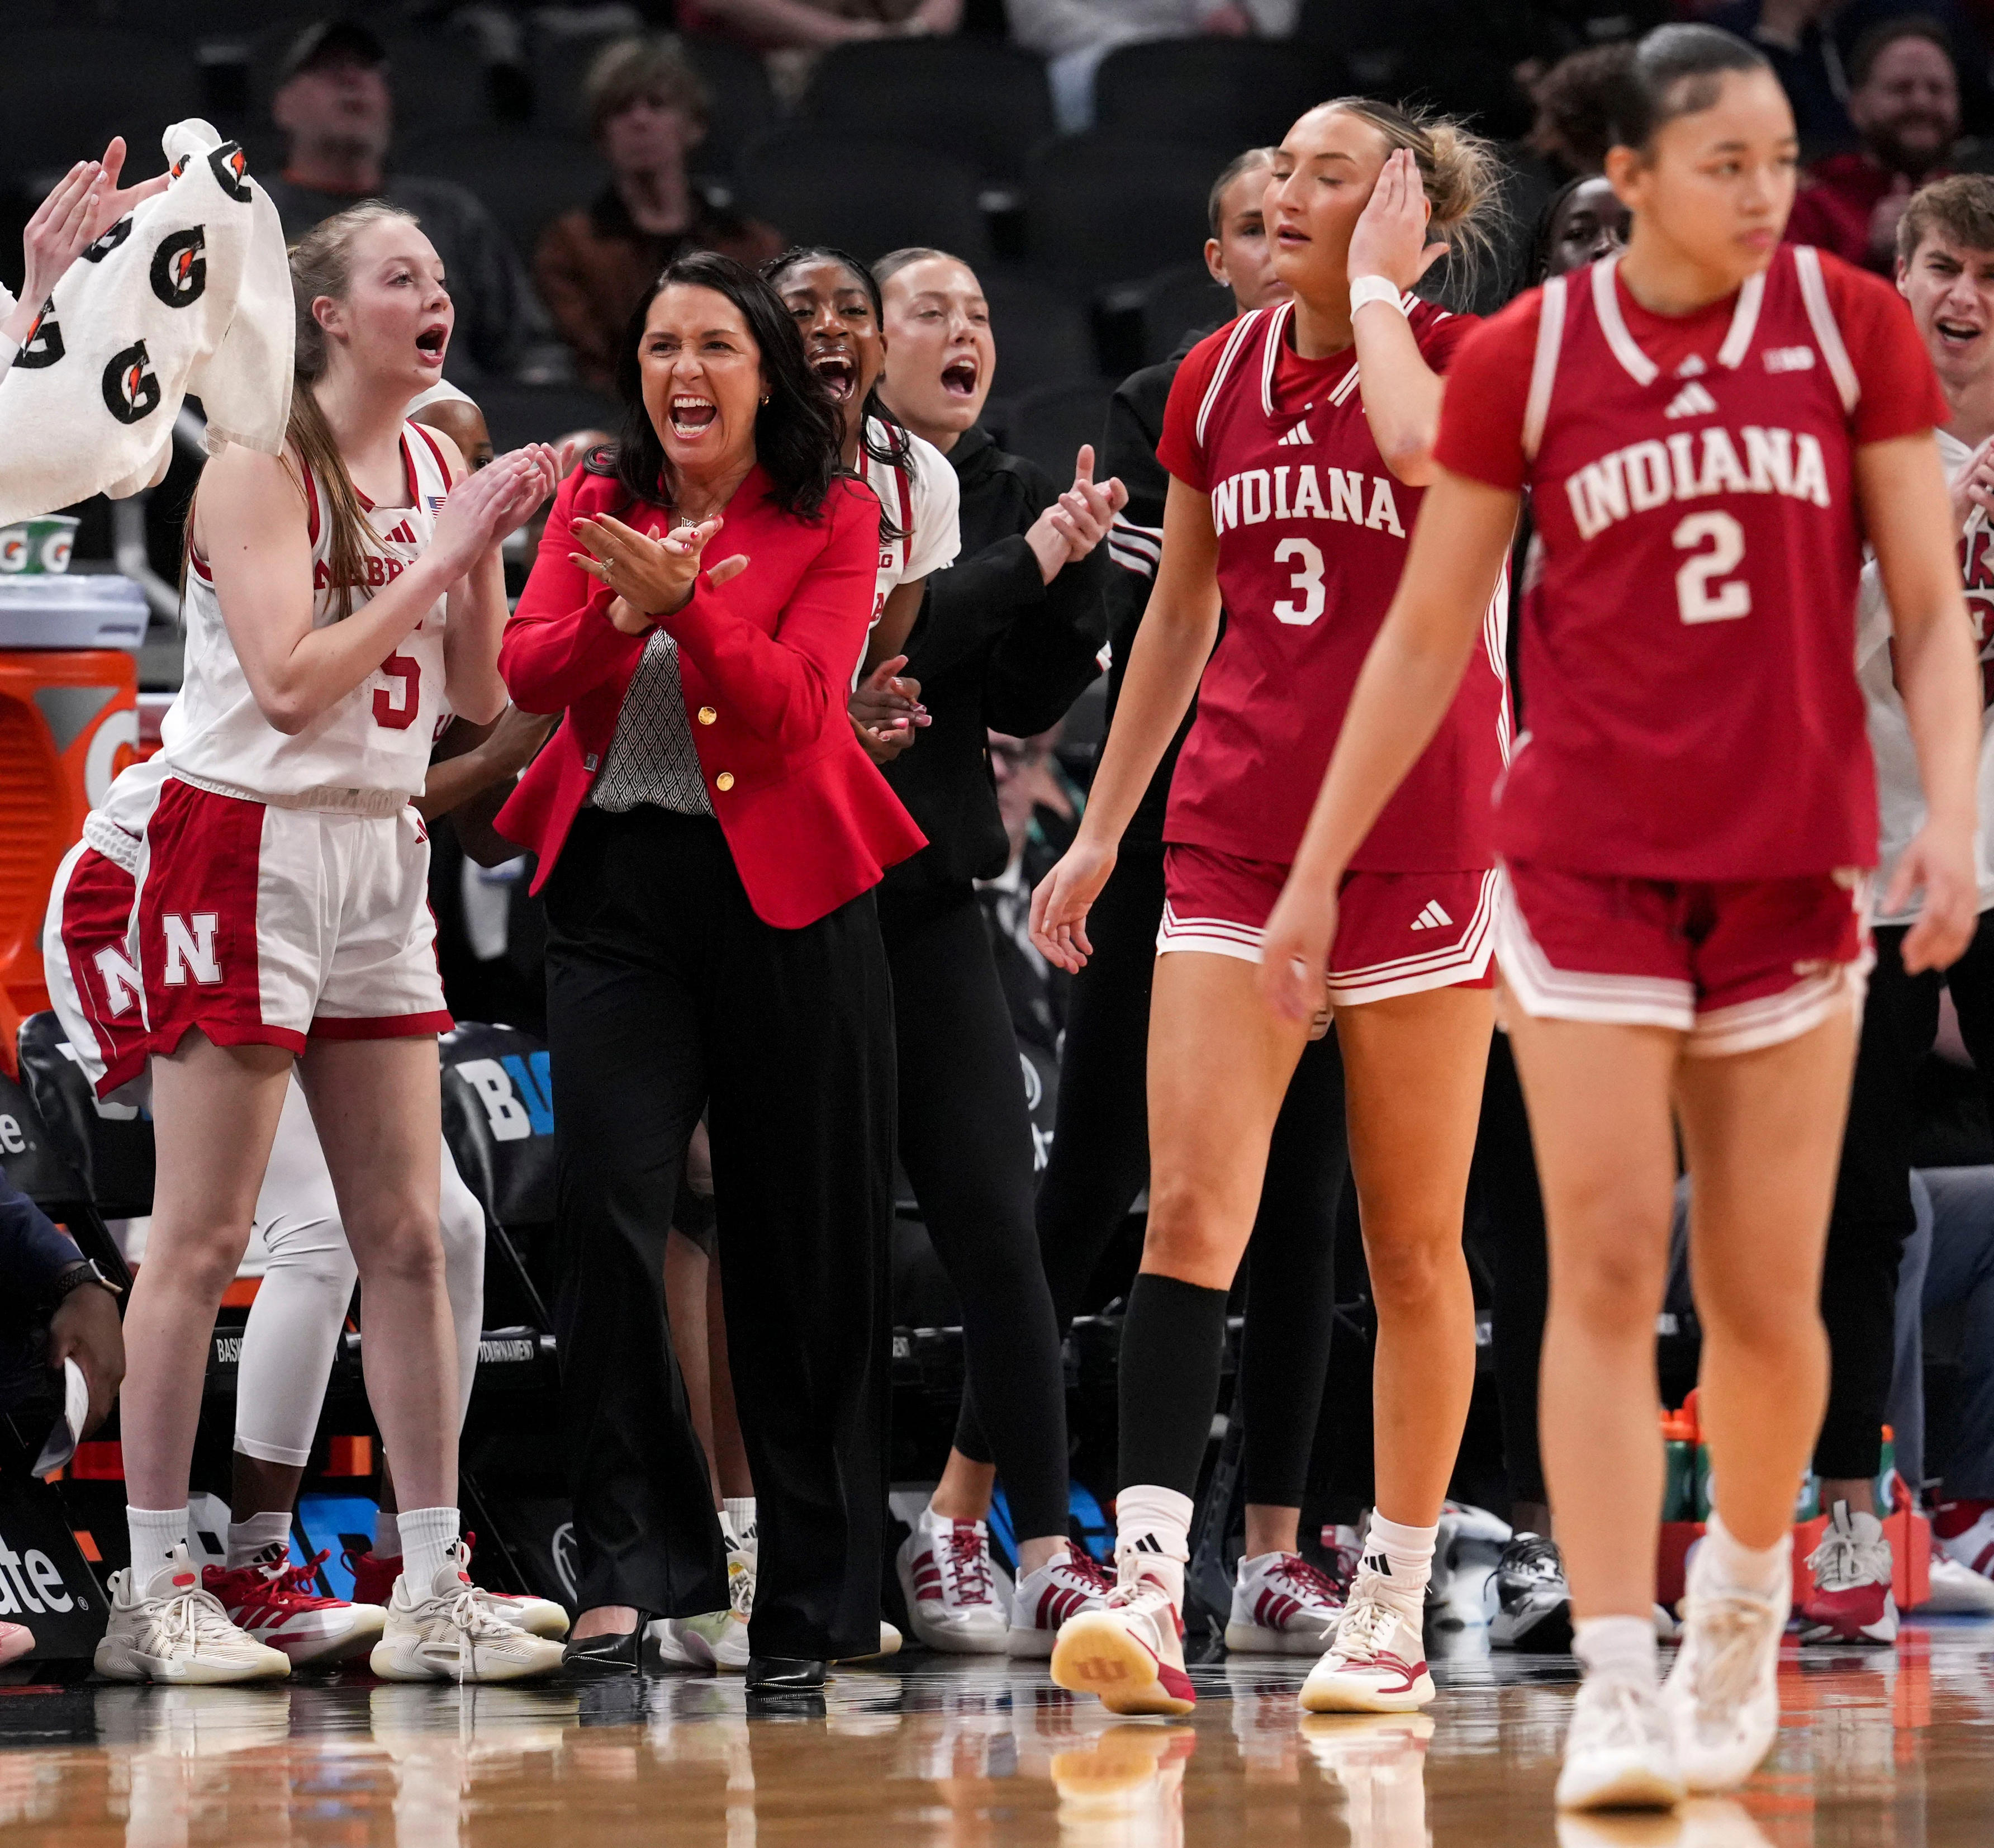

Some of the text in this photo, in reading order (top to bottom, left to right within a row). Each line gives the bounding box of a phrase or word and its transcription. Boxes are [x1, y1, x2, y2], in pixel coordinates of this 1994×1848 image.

[1565, 425, 1830, 541] INDIANA
[1273, 538, 1326, 626] 3
[1672, 509, 1751, 626] 2
[163, 912, 222, 986] N
